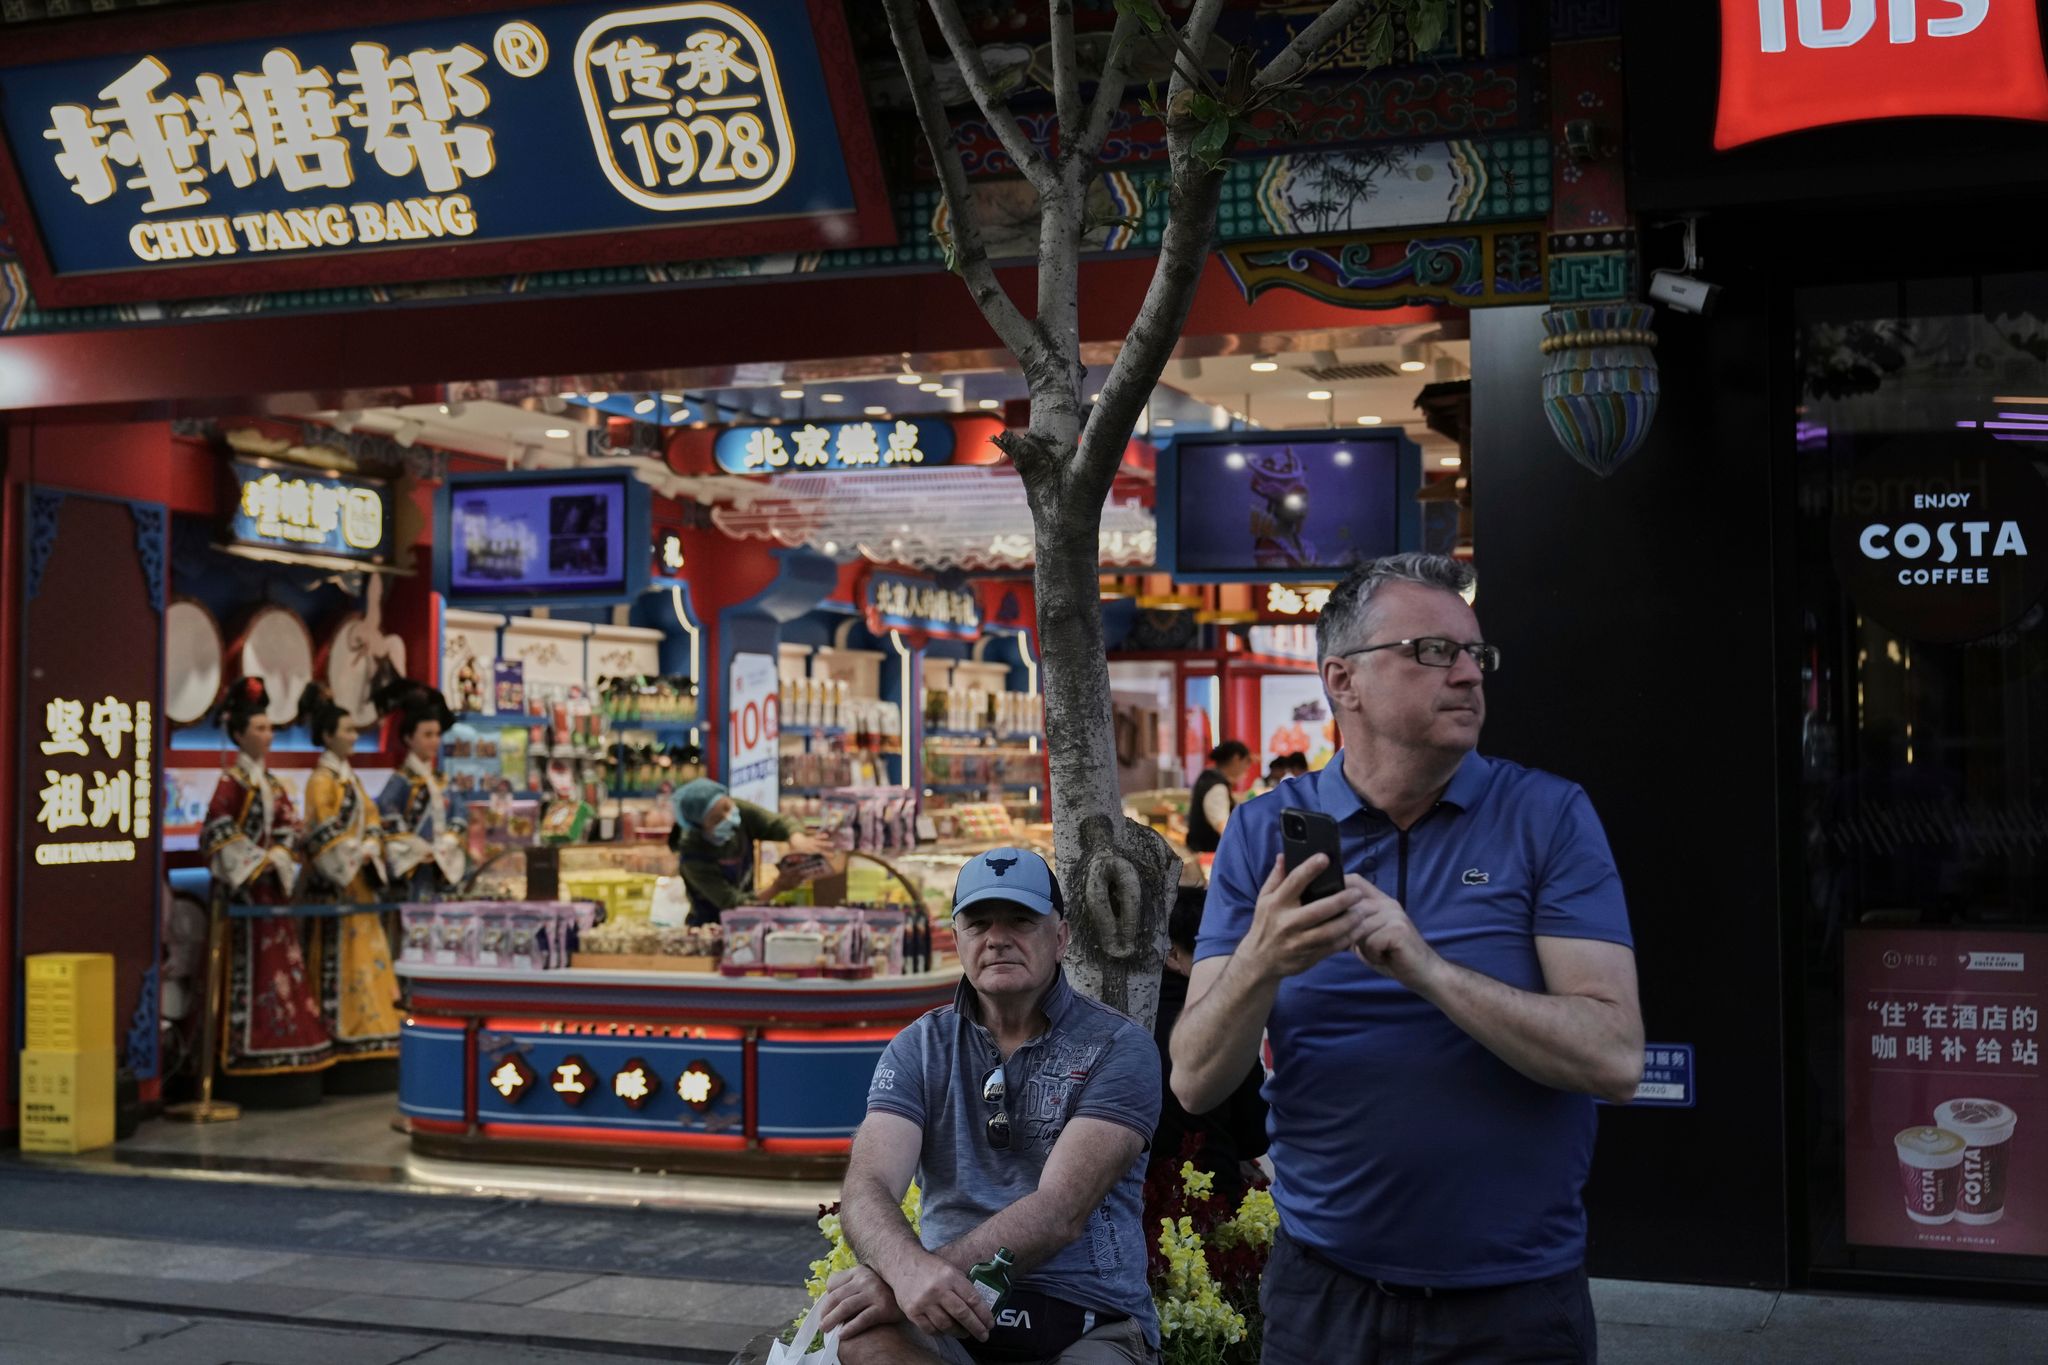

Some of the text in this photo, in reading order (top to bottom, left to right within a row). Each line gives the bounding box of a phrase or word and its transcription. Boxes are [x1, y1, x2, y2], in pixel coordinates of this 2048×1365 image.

[589, 29, 761, 103] 传承
[620, 112, 774, 187] 1928
[129, 195, 477, 261] CHUI TANG BANG
[1914, 493, 1970, 509] ENJOY
[1859, 520, 2028, 563] COSTA
[1898, 568, 1989, 585] COFFEE
[40, 696, 134, 758] 坚守
[37, 769, 131, 833] 祖训
[1867, 1001, 2039, 1032] “住”在酒店的
[1871, 1035, 2039, 1065] 咖啡补给站
[1922, 1170, 1935, 1211] COSTA
[1964, 1149, 1982, 1205] COSTA
[996, 1309, 1032, 1329] SA
